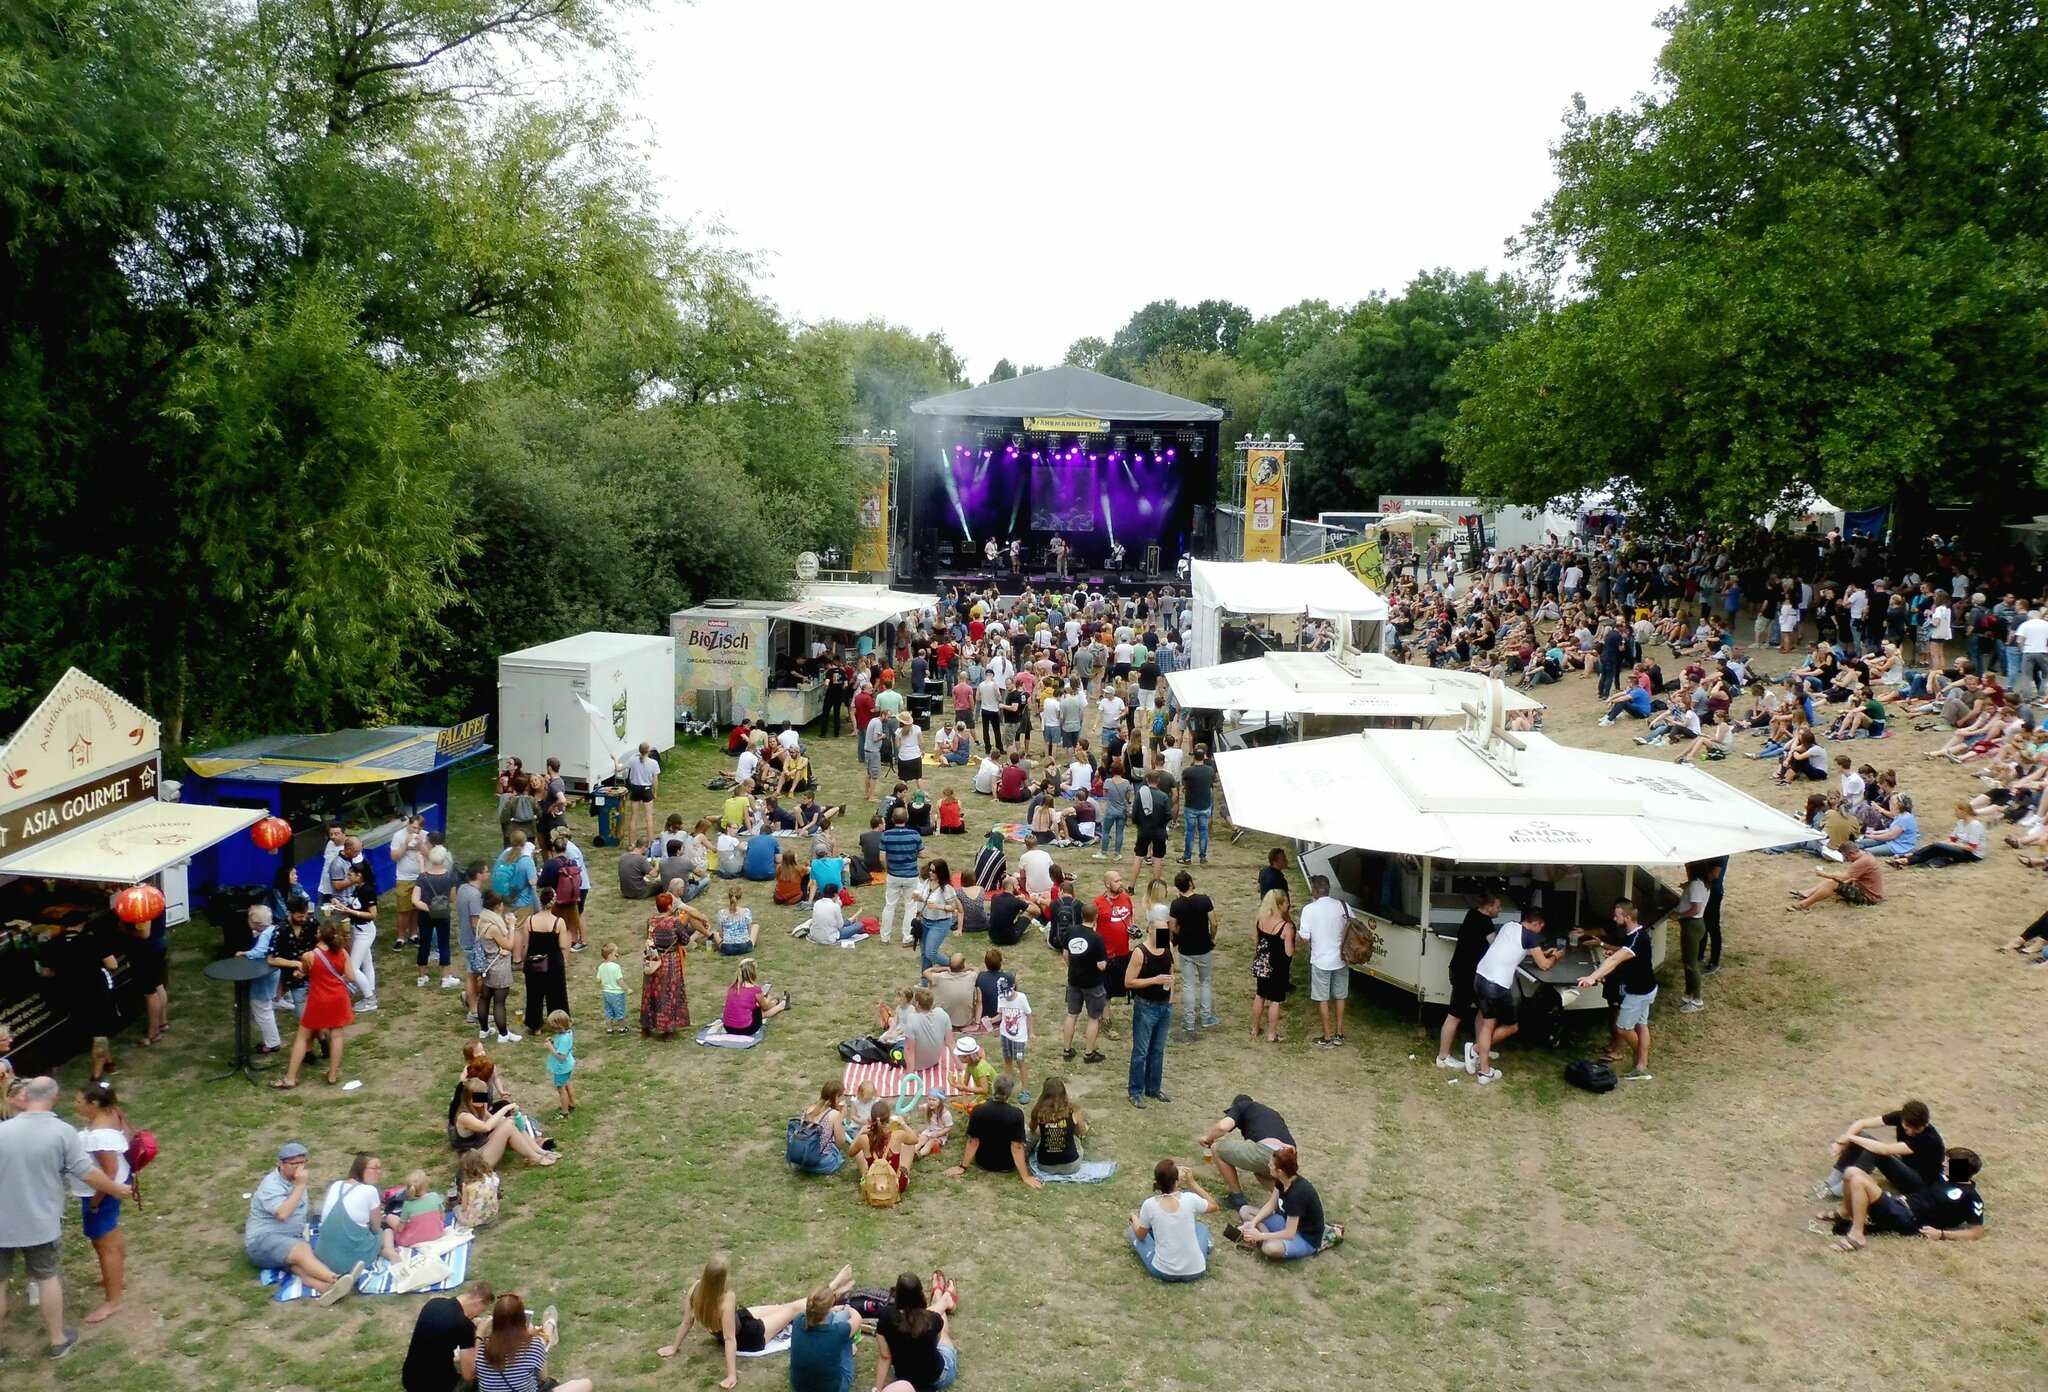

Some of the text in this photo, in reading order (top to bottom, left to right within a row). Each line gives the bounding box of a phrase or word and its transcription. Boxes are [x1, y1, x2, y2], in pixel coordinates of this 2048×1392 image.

[1254, 498, 1274, 513] 21
[689, 630, 748, 651] BioZisch
[40, 694, 72, 752] Asiatische
[438, 715, 487, 748] FALAFEL
[22, 778, 130, 839] ASIA GOURMET
